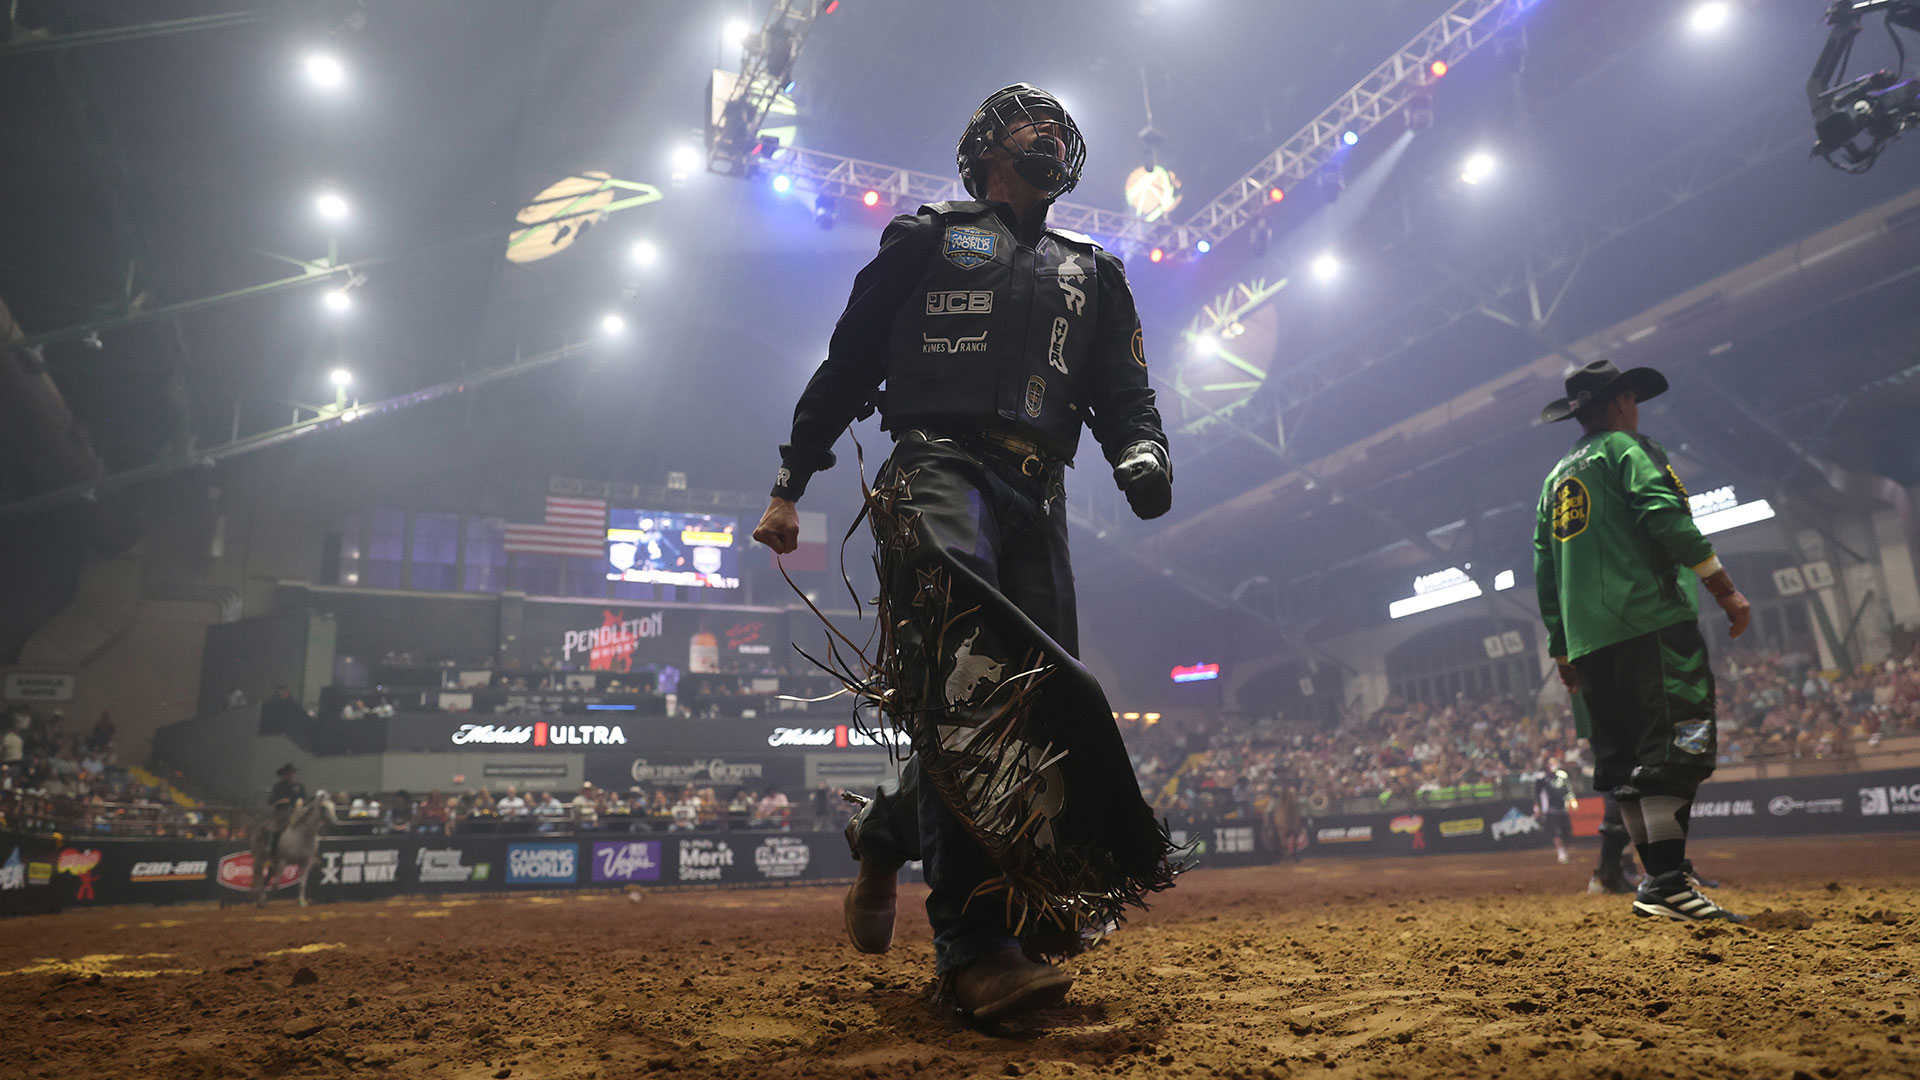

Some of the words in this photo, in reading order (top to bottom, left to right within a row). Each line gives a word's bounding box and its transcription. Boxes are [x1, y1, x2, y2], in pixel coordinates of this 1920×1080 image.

[951, 232, 991, 244] CAMPING
[951, 239, 990, 250] WORLD
[929, 293, 991, 312] JCB
[922, 343, 946, 353] KIMES
[960, 342, 987, 353] RANCH
[1051, 319, 1067, 366] HYER
[562, 611, 663, 661] PENDLETON
[550, 725, 626, 745] ULTRA
[1733, 800, 1755, 815] OIL
[511, 849, 574, 863] CAMPING
[679, 842, 734, 866] Merit
[511, 863, 574, 877] WORLD
[679, 866, 721, 880] Street
